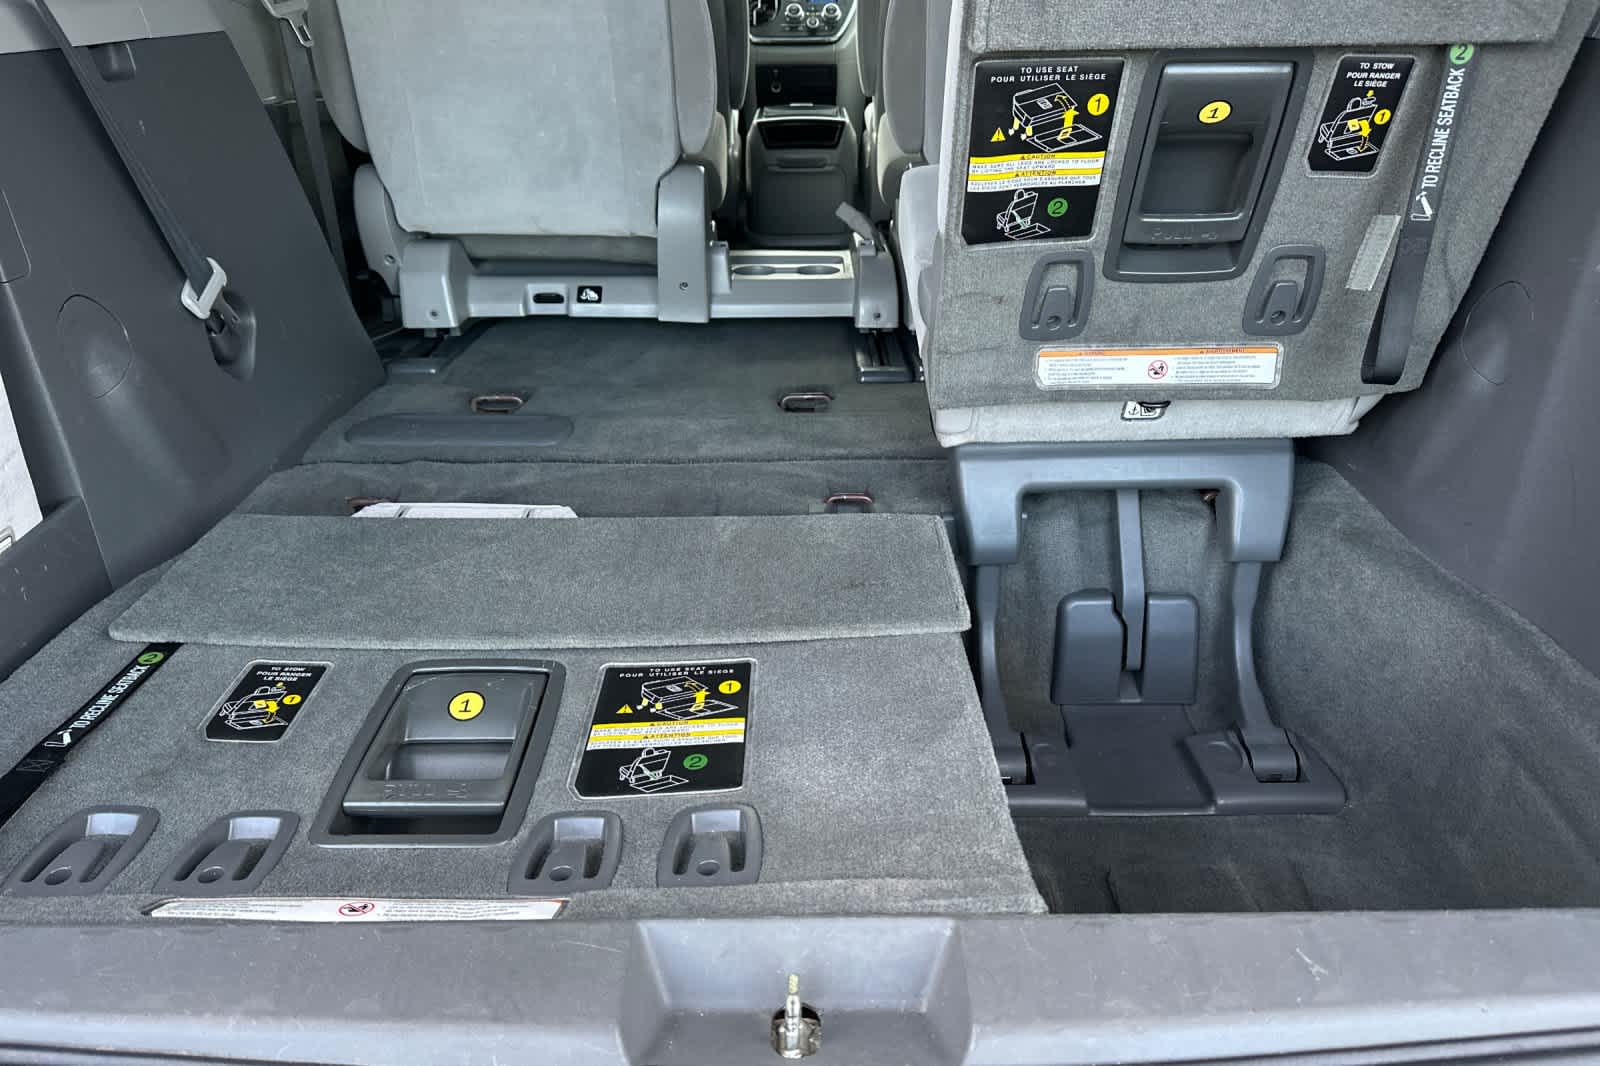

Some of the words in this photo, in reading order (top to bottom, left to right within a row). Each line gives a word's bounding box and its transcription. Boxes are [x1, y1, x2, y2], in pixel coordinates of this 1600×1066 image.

[1021, 66, 1032, 74] TO
[1056, 65, 1079, 73] SEAT
[1360, 62, 1371, 70] TO
[1373, 62, 1395, 70] STOW
[990, 75, 1015, 83] POUR
[1020, 74, 1061, 82] UTILISER
[1346, 71, 1368, 79] POUR
[1369, 71, 1401, 80] RANGER
[1437, 67, 1467, 127] SEATBACK
[1425, 127, 1451, 174] RECLINE
[1421, 174, 1439, 189] TO
[69, 719, 91, 729] TO
[80, 694, 120, 721] RECLINE
[107, 664, 152, 694] SEATBACK
